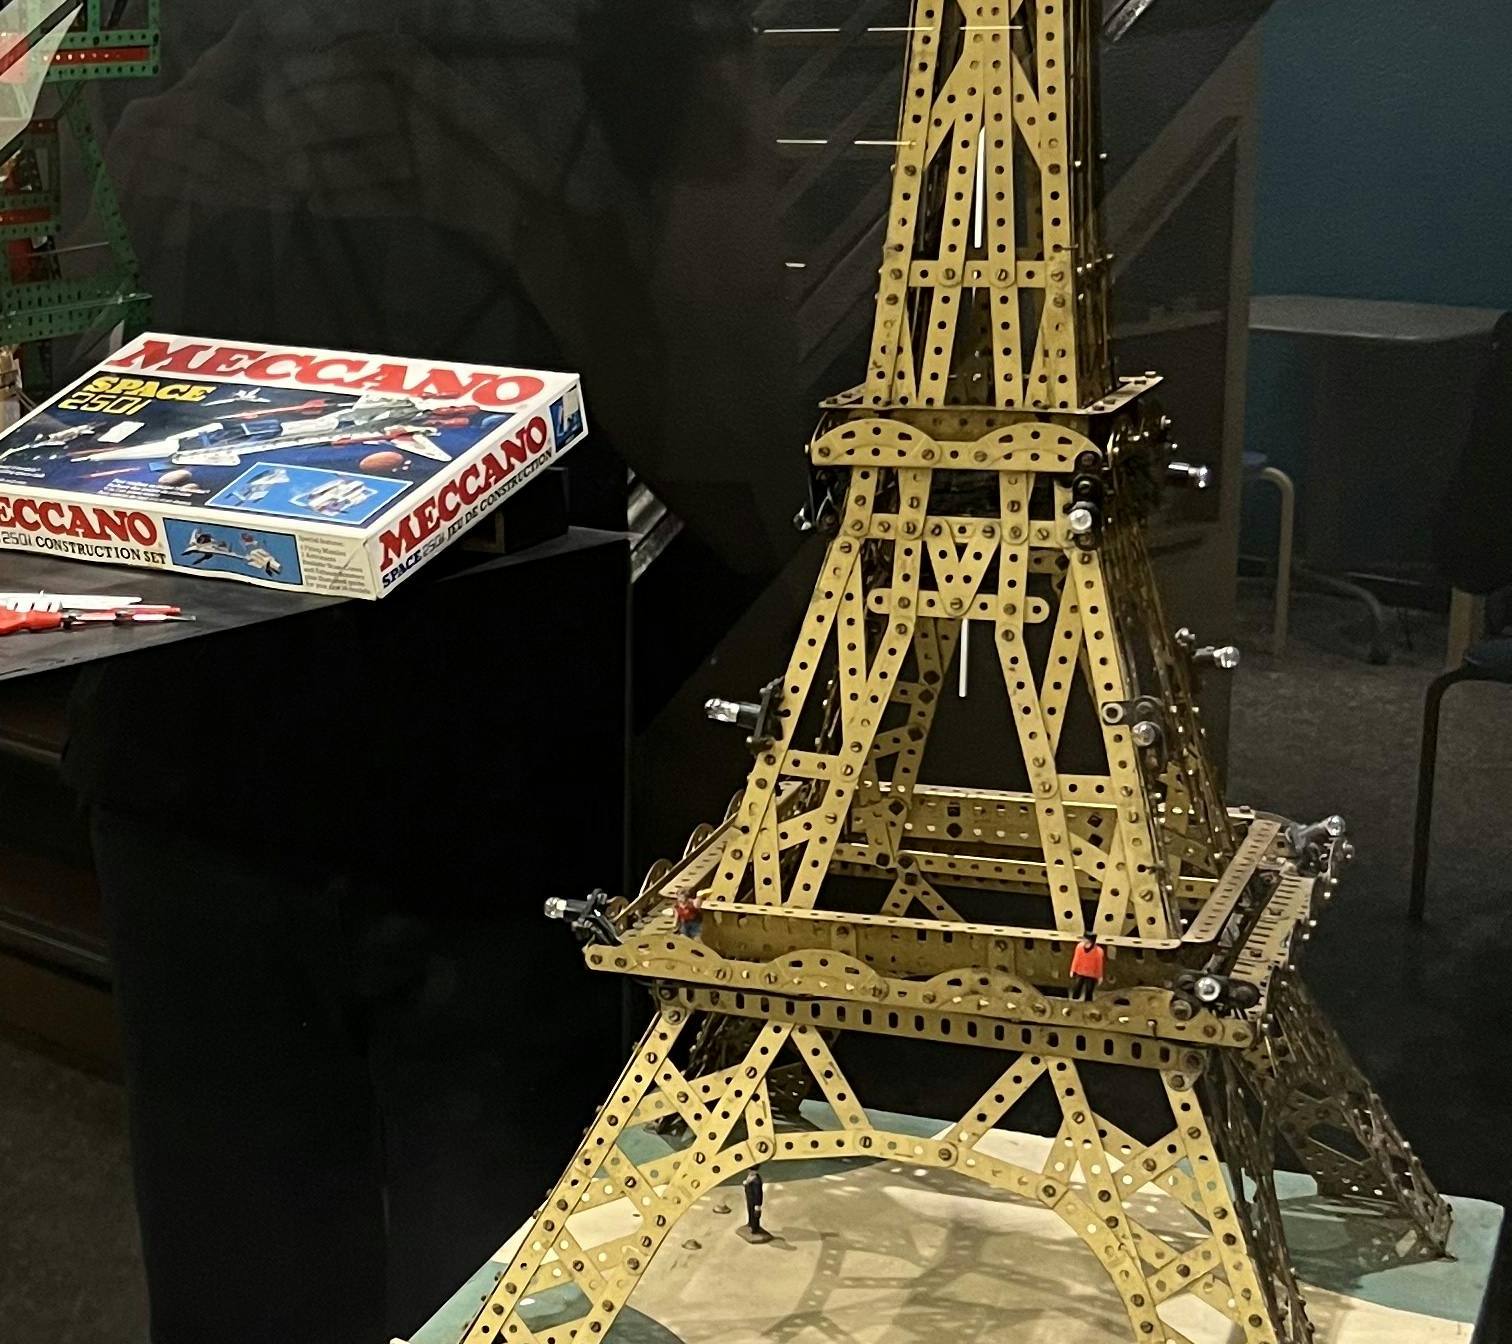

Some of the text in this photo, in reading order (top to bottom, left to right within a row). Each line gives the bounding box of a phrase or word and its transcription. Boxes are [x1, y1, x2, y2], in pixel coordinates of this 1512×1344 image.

[85, 375, 217, 402] SPACE
[108, 340, 545, 406] MECCANO
[58, 392, 150, 416] 2501
[379, 415, 548, 573] MECCANO
[382, 549, 423, 589] SPACE
[447, 516, 464, 541] JEU
[465, 506, 480, 525] DE
[480, 446, 553, 513] CONSTRUCTION
[1, 531, 33, 546] 2501
[35, 535, 142, 562] CONSTRUCTION
[143, 550, 167, 565] SET
